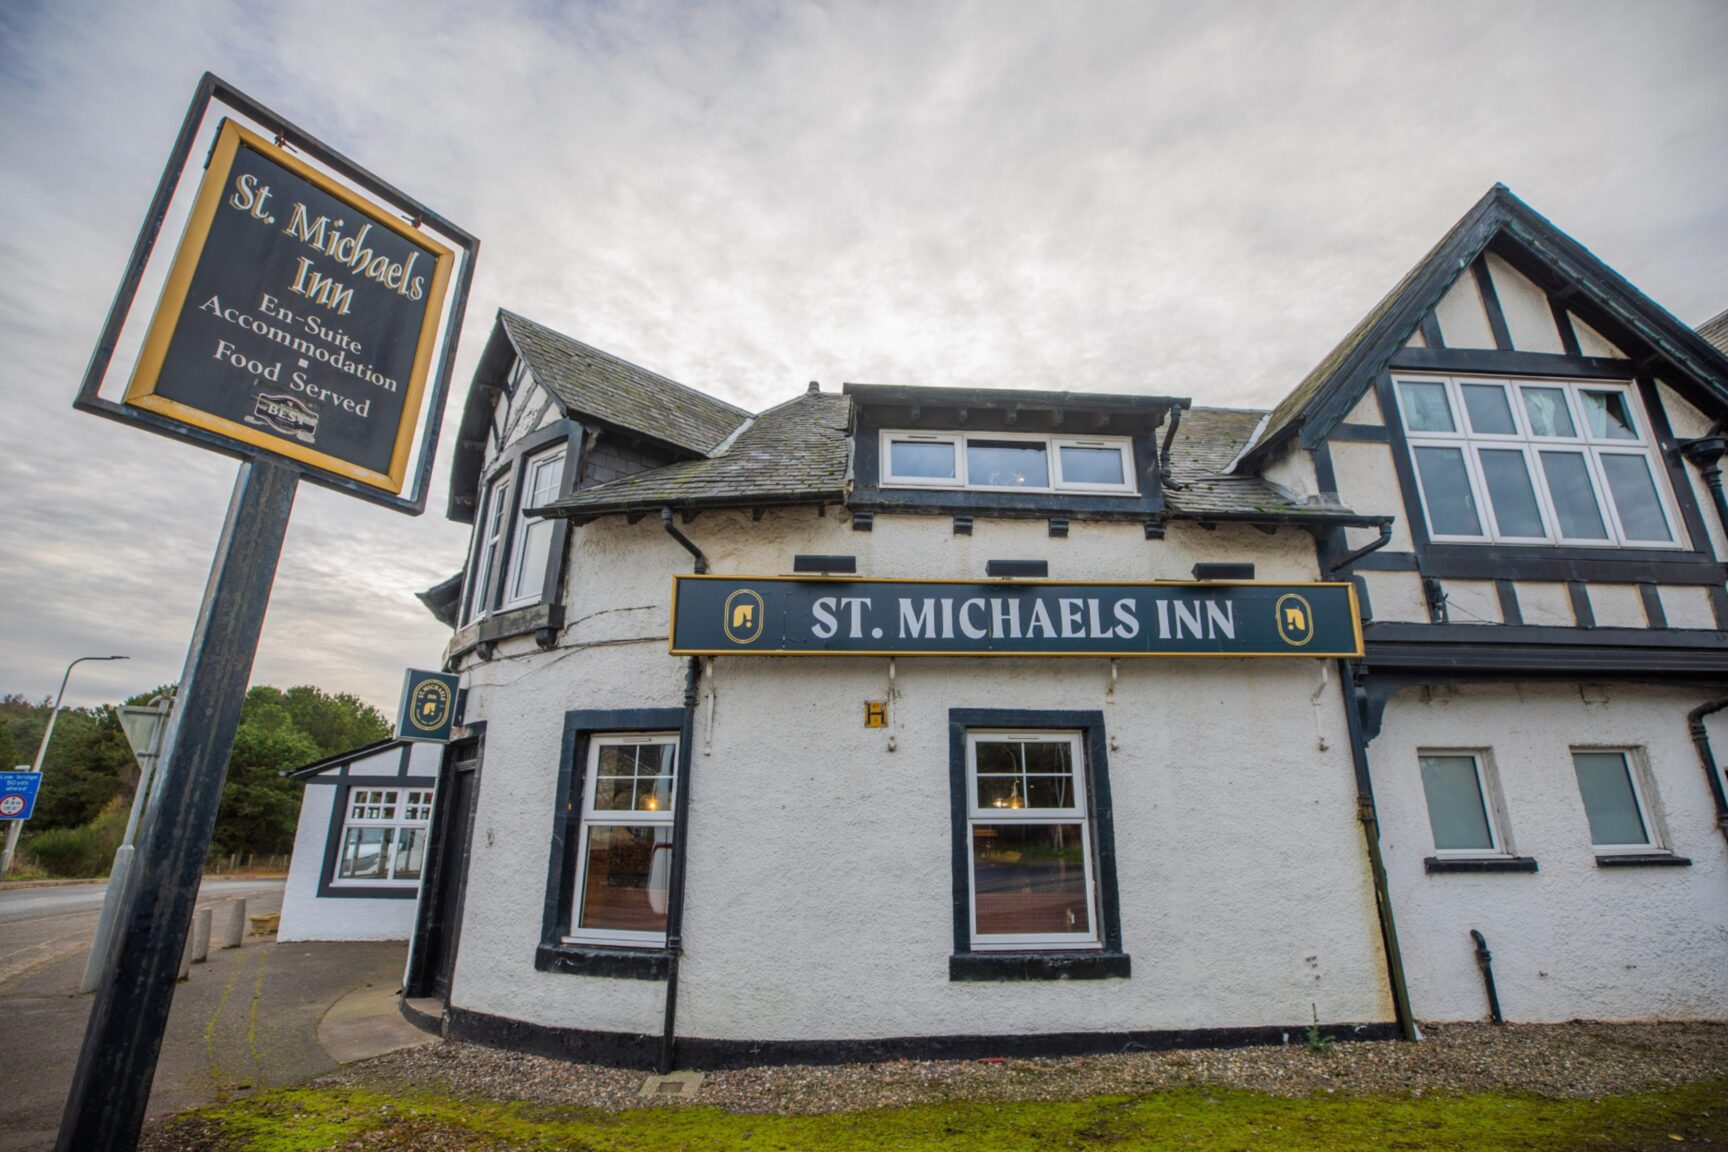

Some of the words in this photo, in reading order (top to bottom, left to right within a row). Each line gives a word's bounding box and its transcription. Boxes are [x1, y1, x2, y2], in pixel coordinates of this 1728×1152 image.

[230, 174, 275, 224] St.
[281, 202, 425, 300] Michaels
[288, 256, 354, 315] Inn
[199, 295, 398, 392] Accommodation
[258, 293, 362, 355] En-Suite
[213, 339, 282, 382] Food
[289, 372, 371, 418] Served
[268, 403, 305, 425] BEST
[811, 597, 884, 639] ST.
[898, 598, 1140, 639] MICHAELS
[1155, 599, 1236, 639] INN
[867, 703, 885, 725] H
